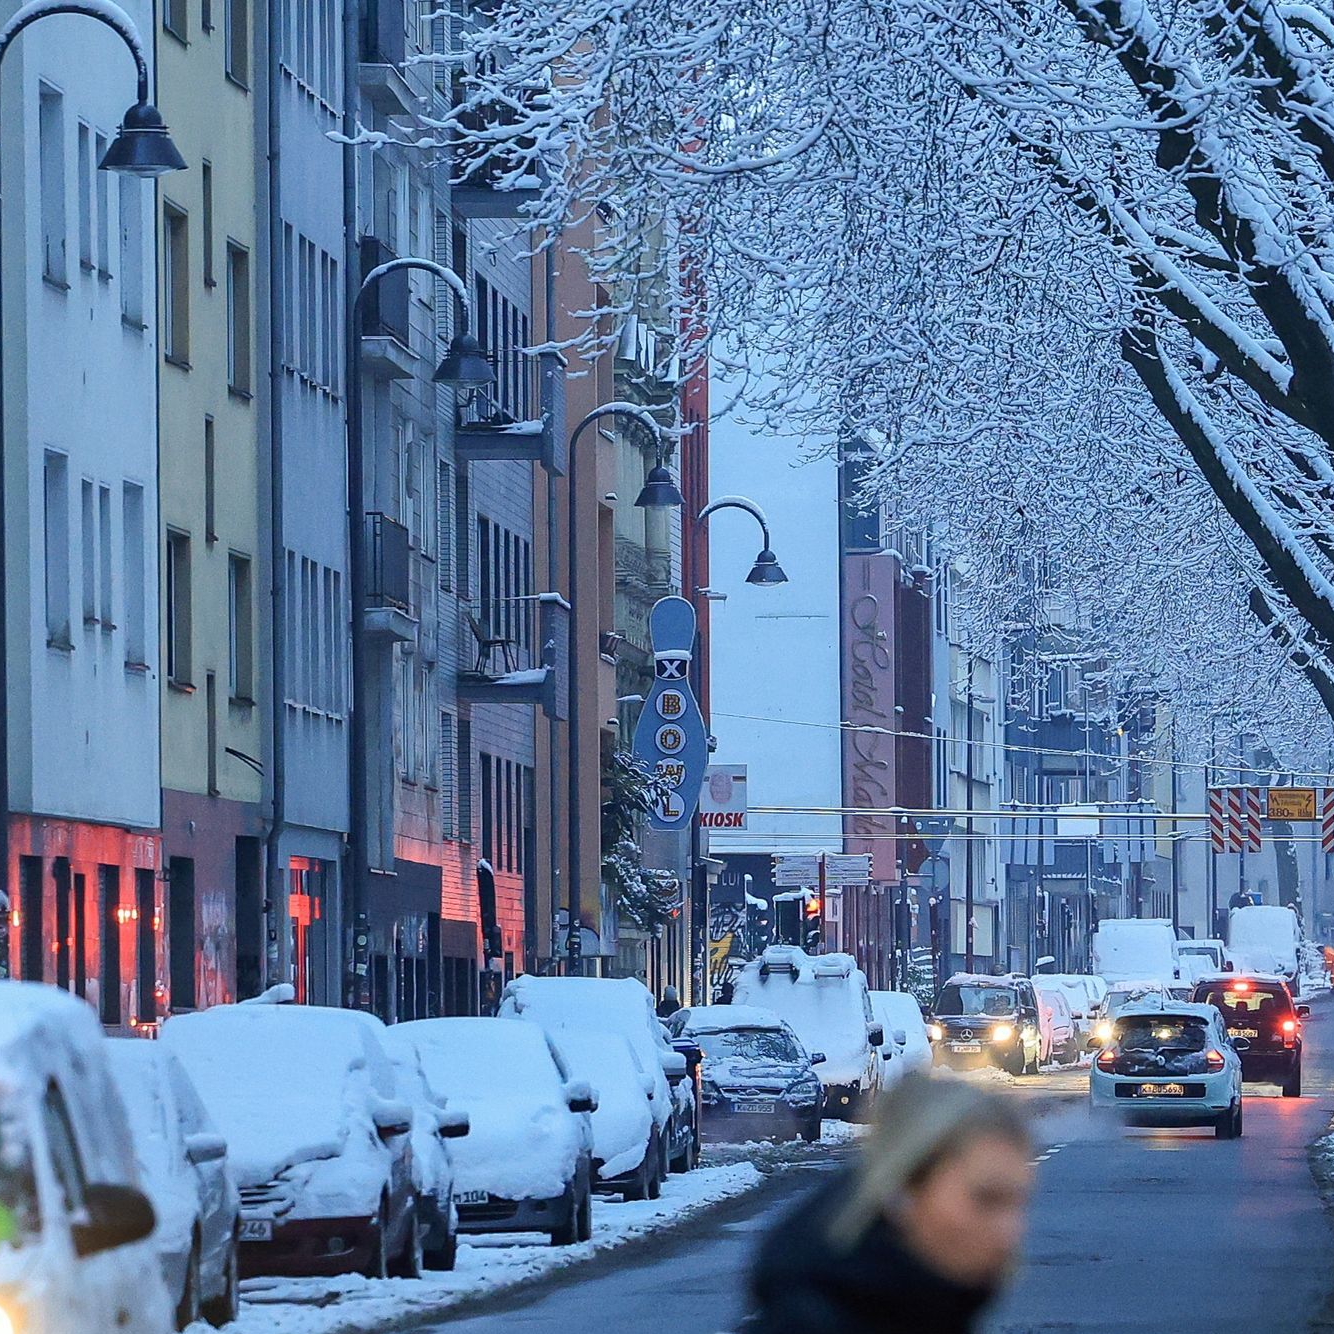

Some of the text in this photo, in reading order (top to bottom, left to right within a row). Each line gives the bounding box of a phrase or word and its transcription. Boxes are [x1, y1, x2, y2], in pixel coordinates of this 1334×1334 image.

[655, 660, 685, 818] X BOWL
[699, 812, 745, 828] KIOSK
